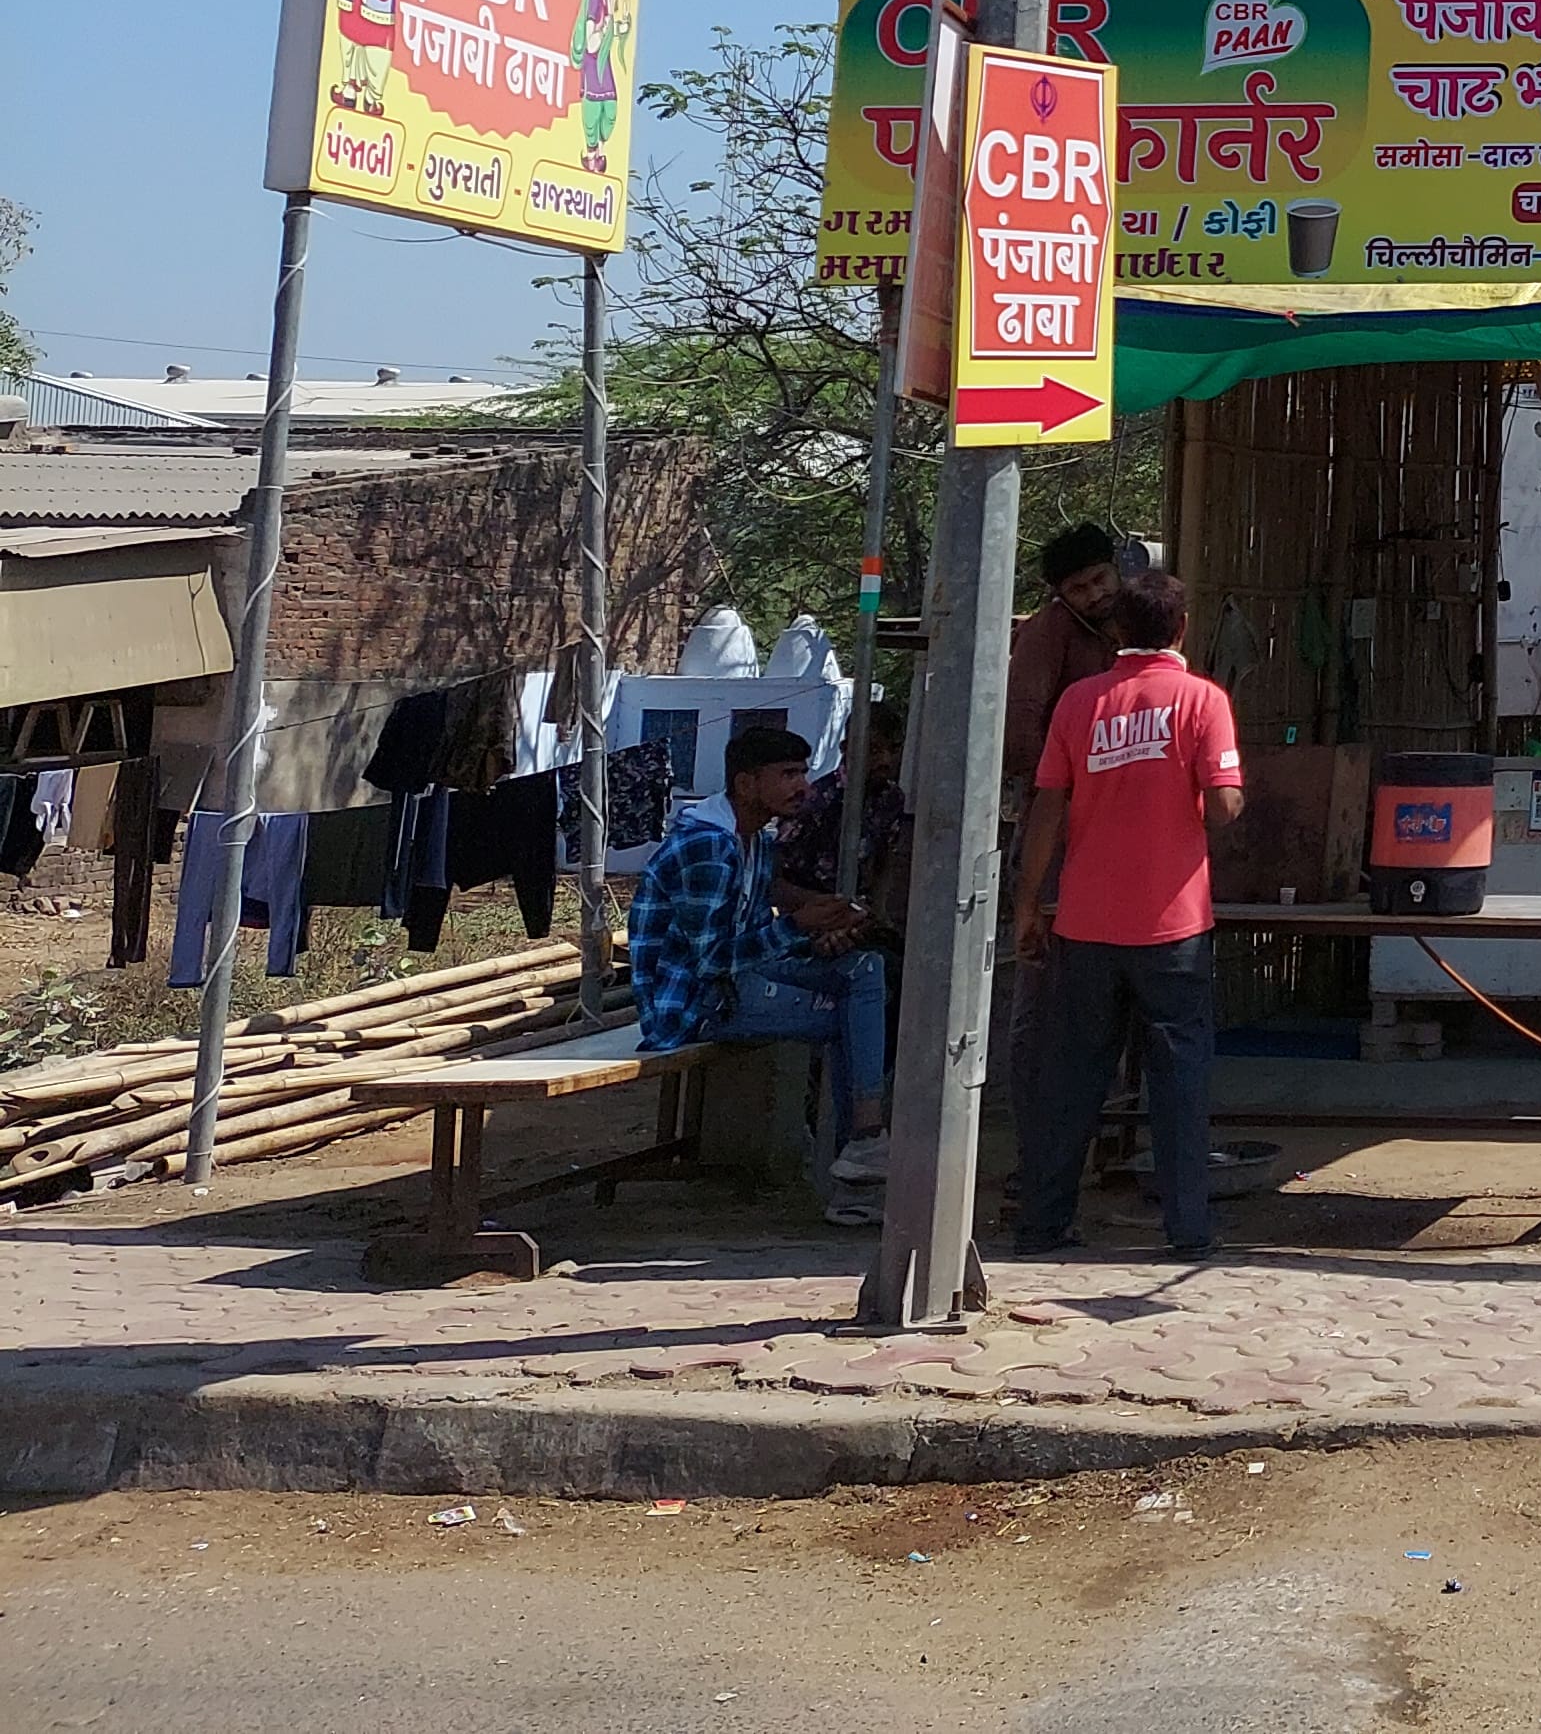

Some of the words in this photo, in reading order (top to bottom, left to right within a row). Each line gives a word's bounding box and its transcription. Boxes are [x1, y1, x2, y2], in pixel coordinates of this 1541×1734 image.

[1213, 19, 1294, 56] PAAN
[1215, 2, 1269, 21] CBR
[504, 35, 570, 108] ढाबा
[1389, 64, 1508, 120] चाट
[326, 121, 393, 178] પંજાબી
[424, 152, 501, 202] ગુજરાતી
[530, 179, 613, 225] રાજસ્થાની
[978, 129, 1102, 205] CBR
[1374, 137, 1465, 169] समोसा
[1203, 198, 1278, 241] કોફી
[977, 212, 1100, 284] पंजाबी
[992, 292, 1081, 346] ढाबा
[1090, 706, 1173, 754] ADHIK
